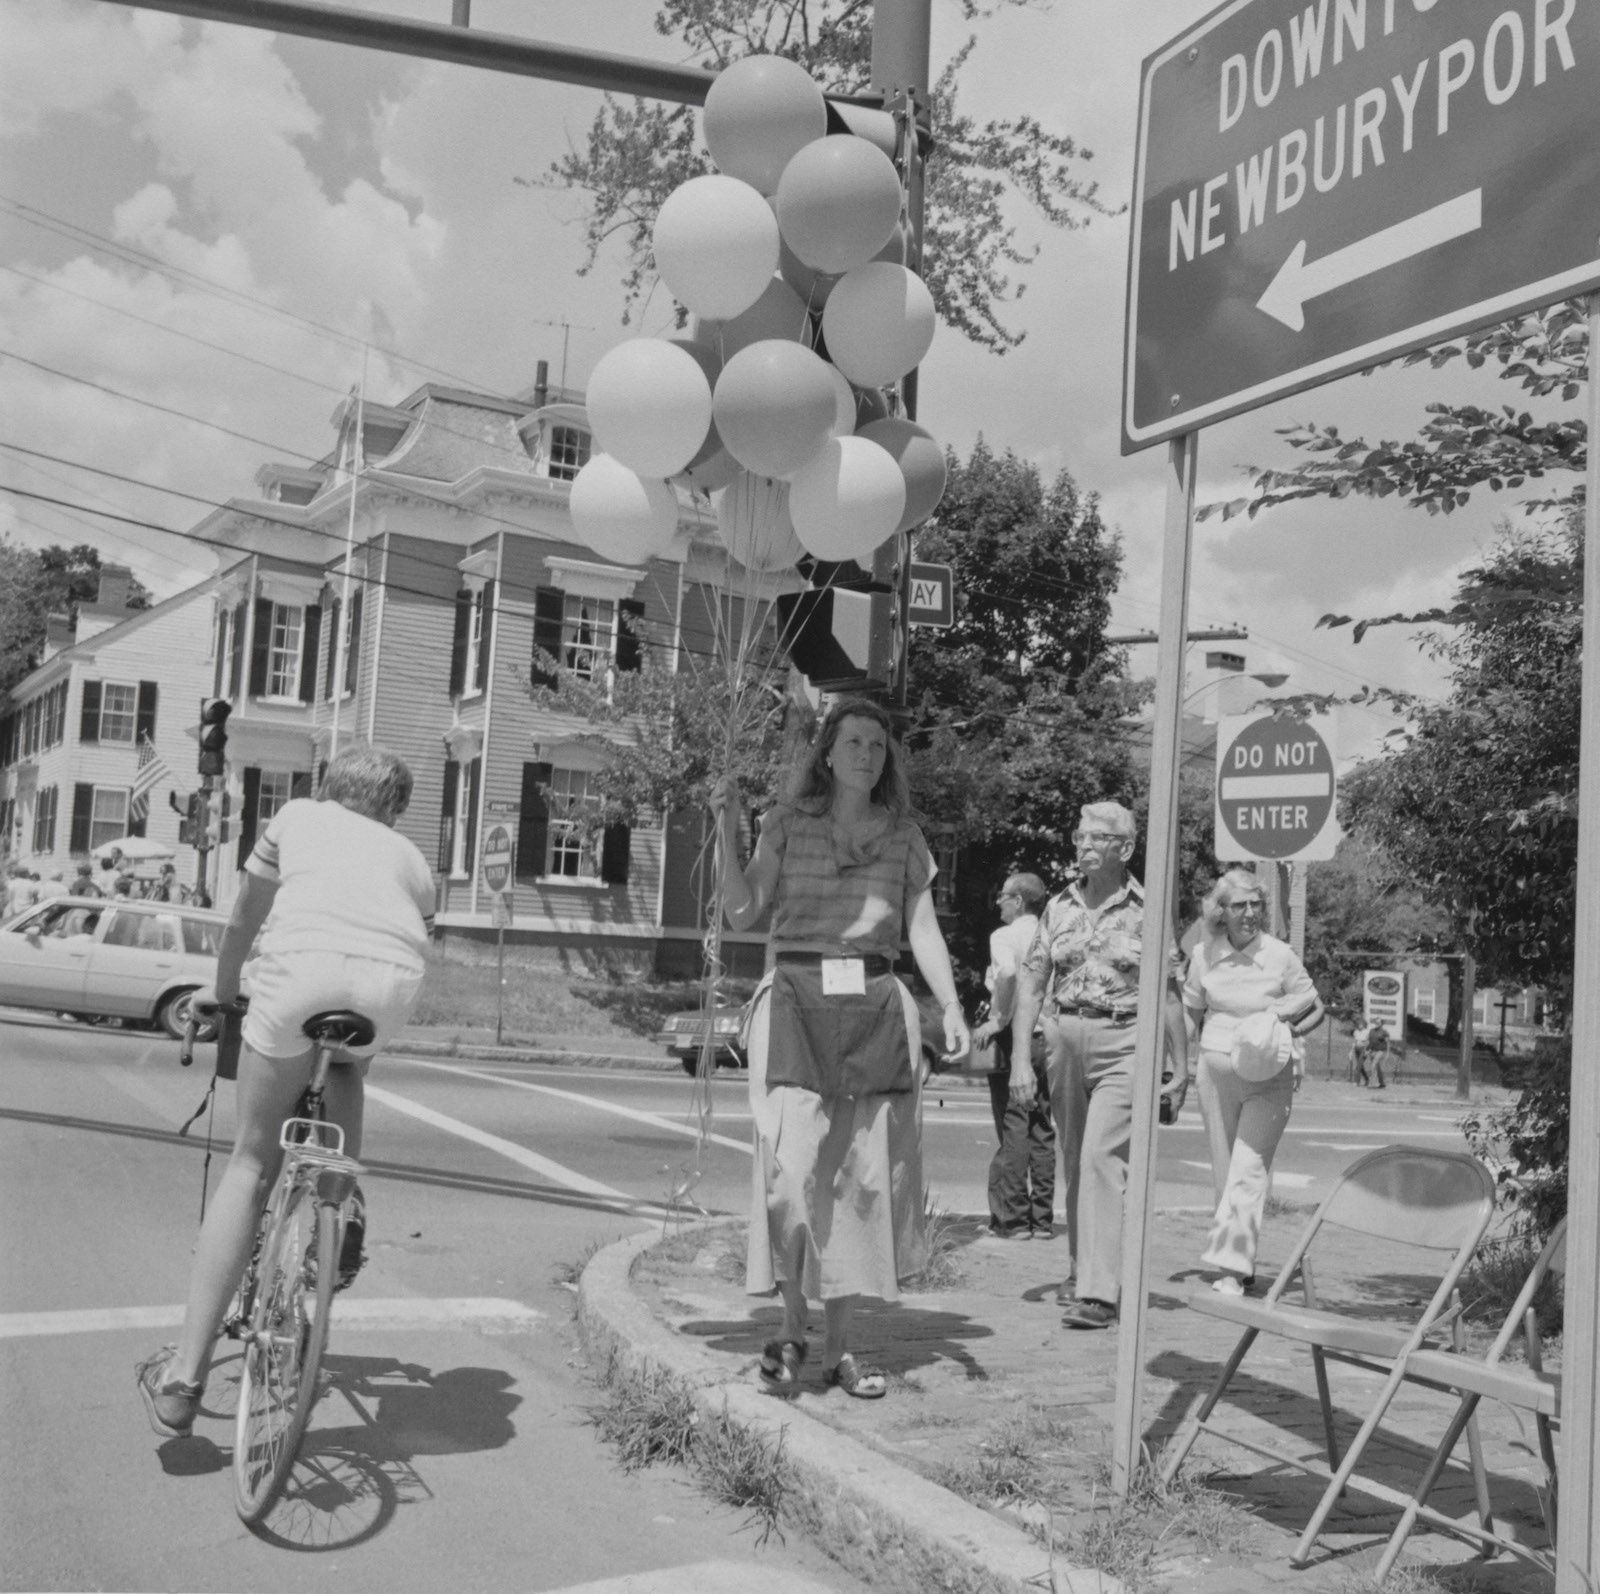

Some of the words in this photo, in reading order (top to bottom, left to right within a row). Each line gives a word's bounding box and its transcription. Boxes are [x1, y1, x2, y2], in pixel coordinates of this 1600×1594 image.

[1219, 0, 1439, 133] DOWN
[1234, 745, 1263, 769] DO
[1275, 741, 1318, 767] NOT
[1237, 805, 1308, 830] ENTER
